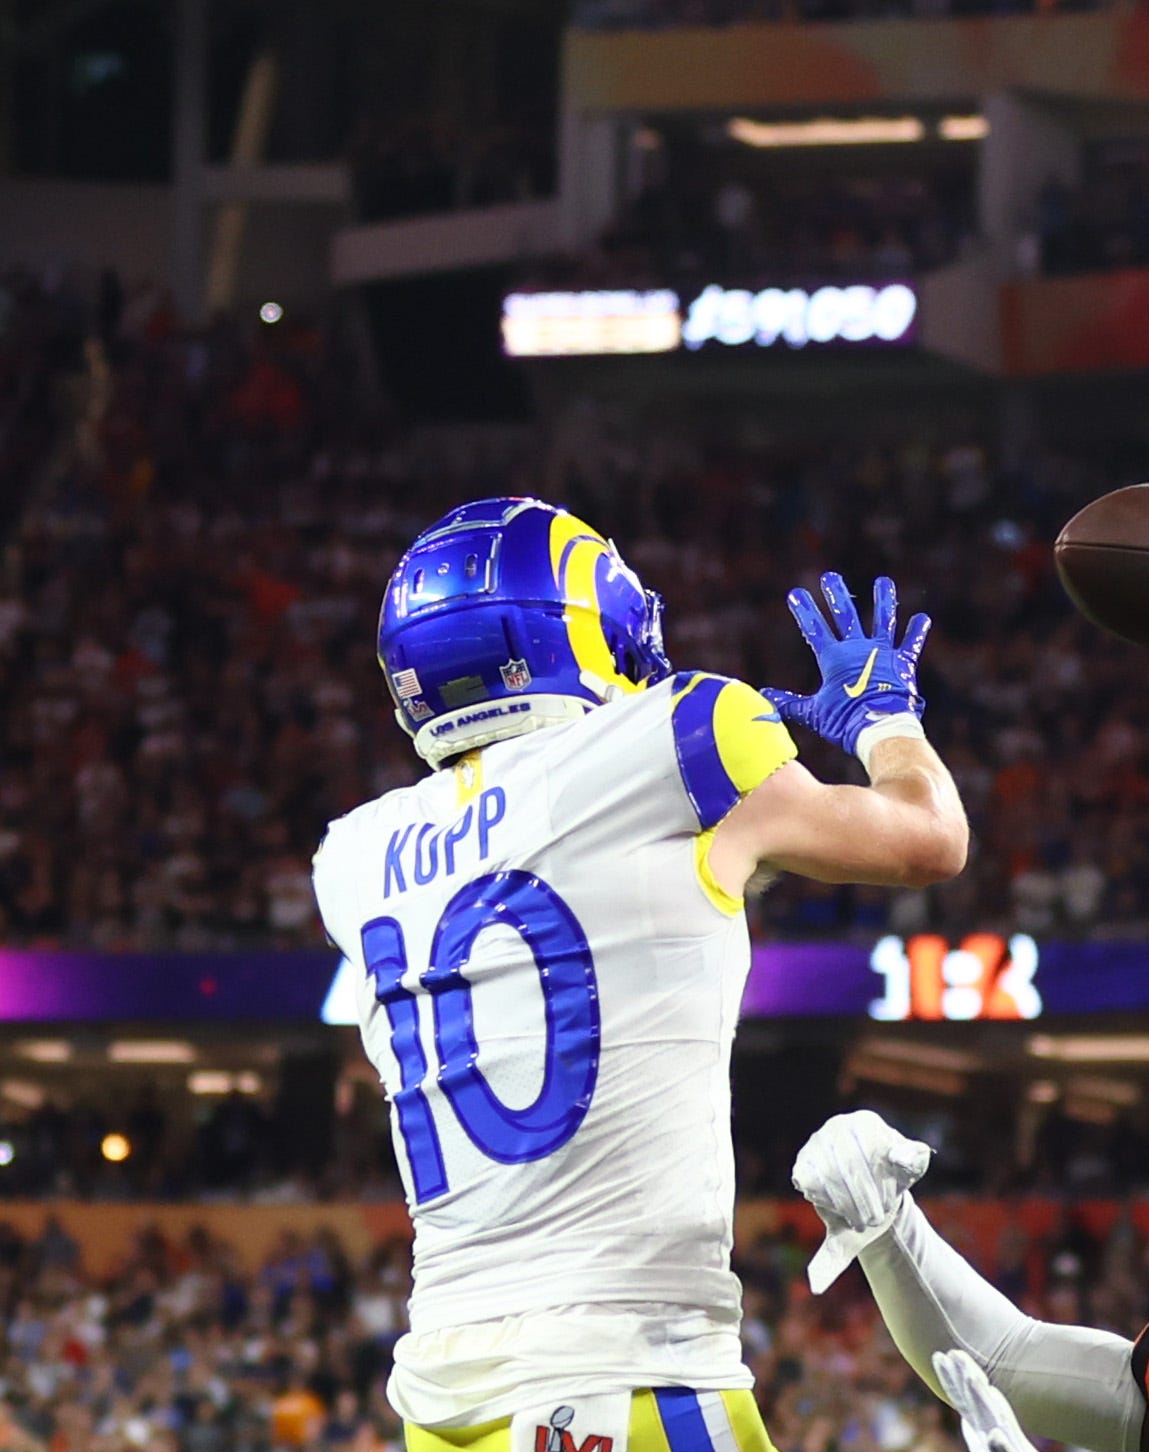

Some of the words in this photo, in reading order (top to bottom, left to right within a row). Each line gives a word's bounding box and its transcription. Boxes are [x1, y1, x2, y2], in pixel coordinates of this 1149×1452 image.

[430, 720, 454, 737] LOS
[457, 703, 531, 727] ANGELES
[384, 786, 506, 899] KUPP
[361, 869, 601, 1206] 10
